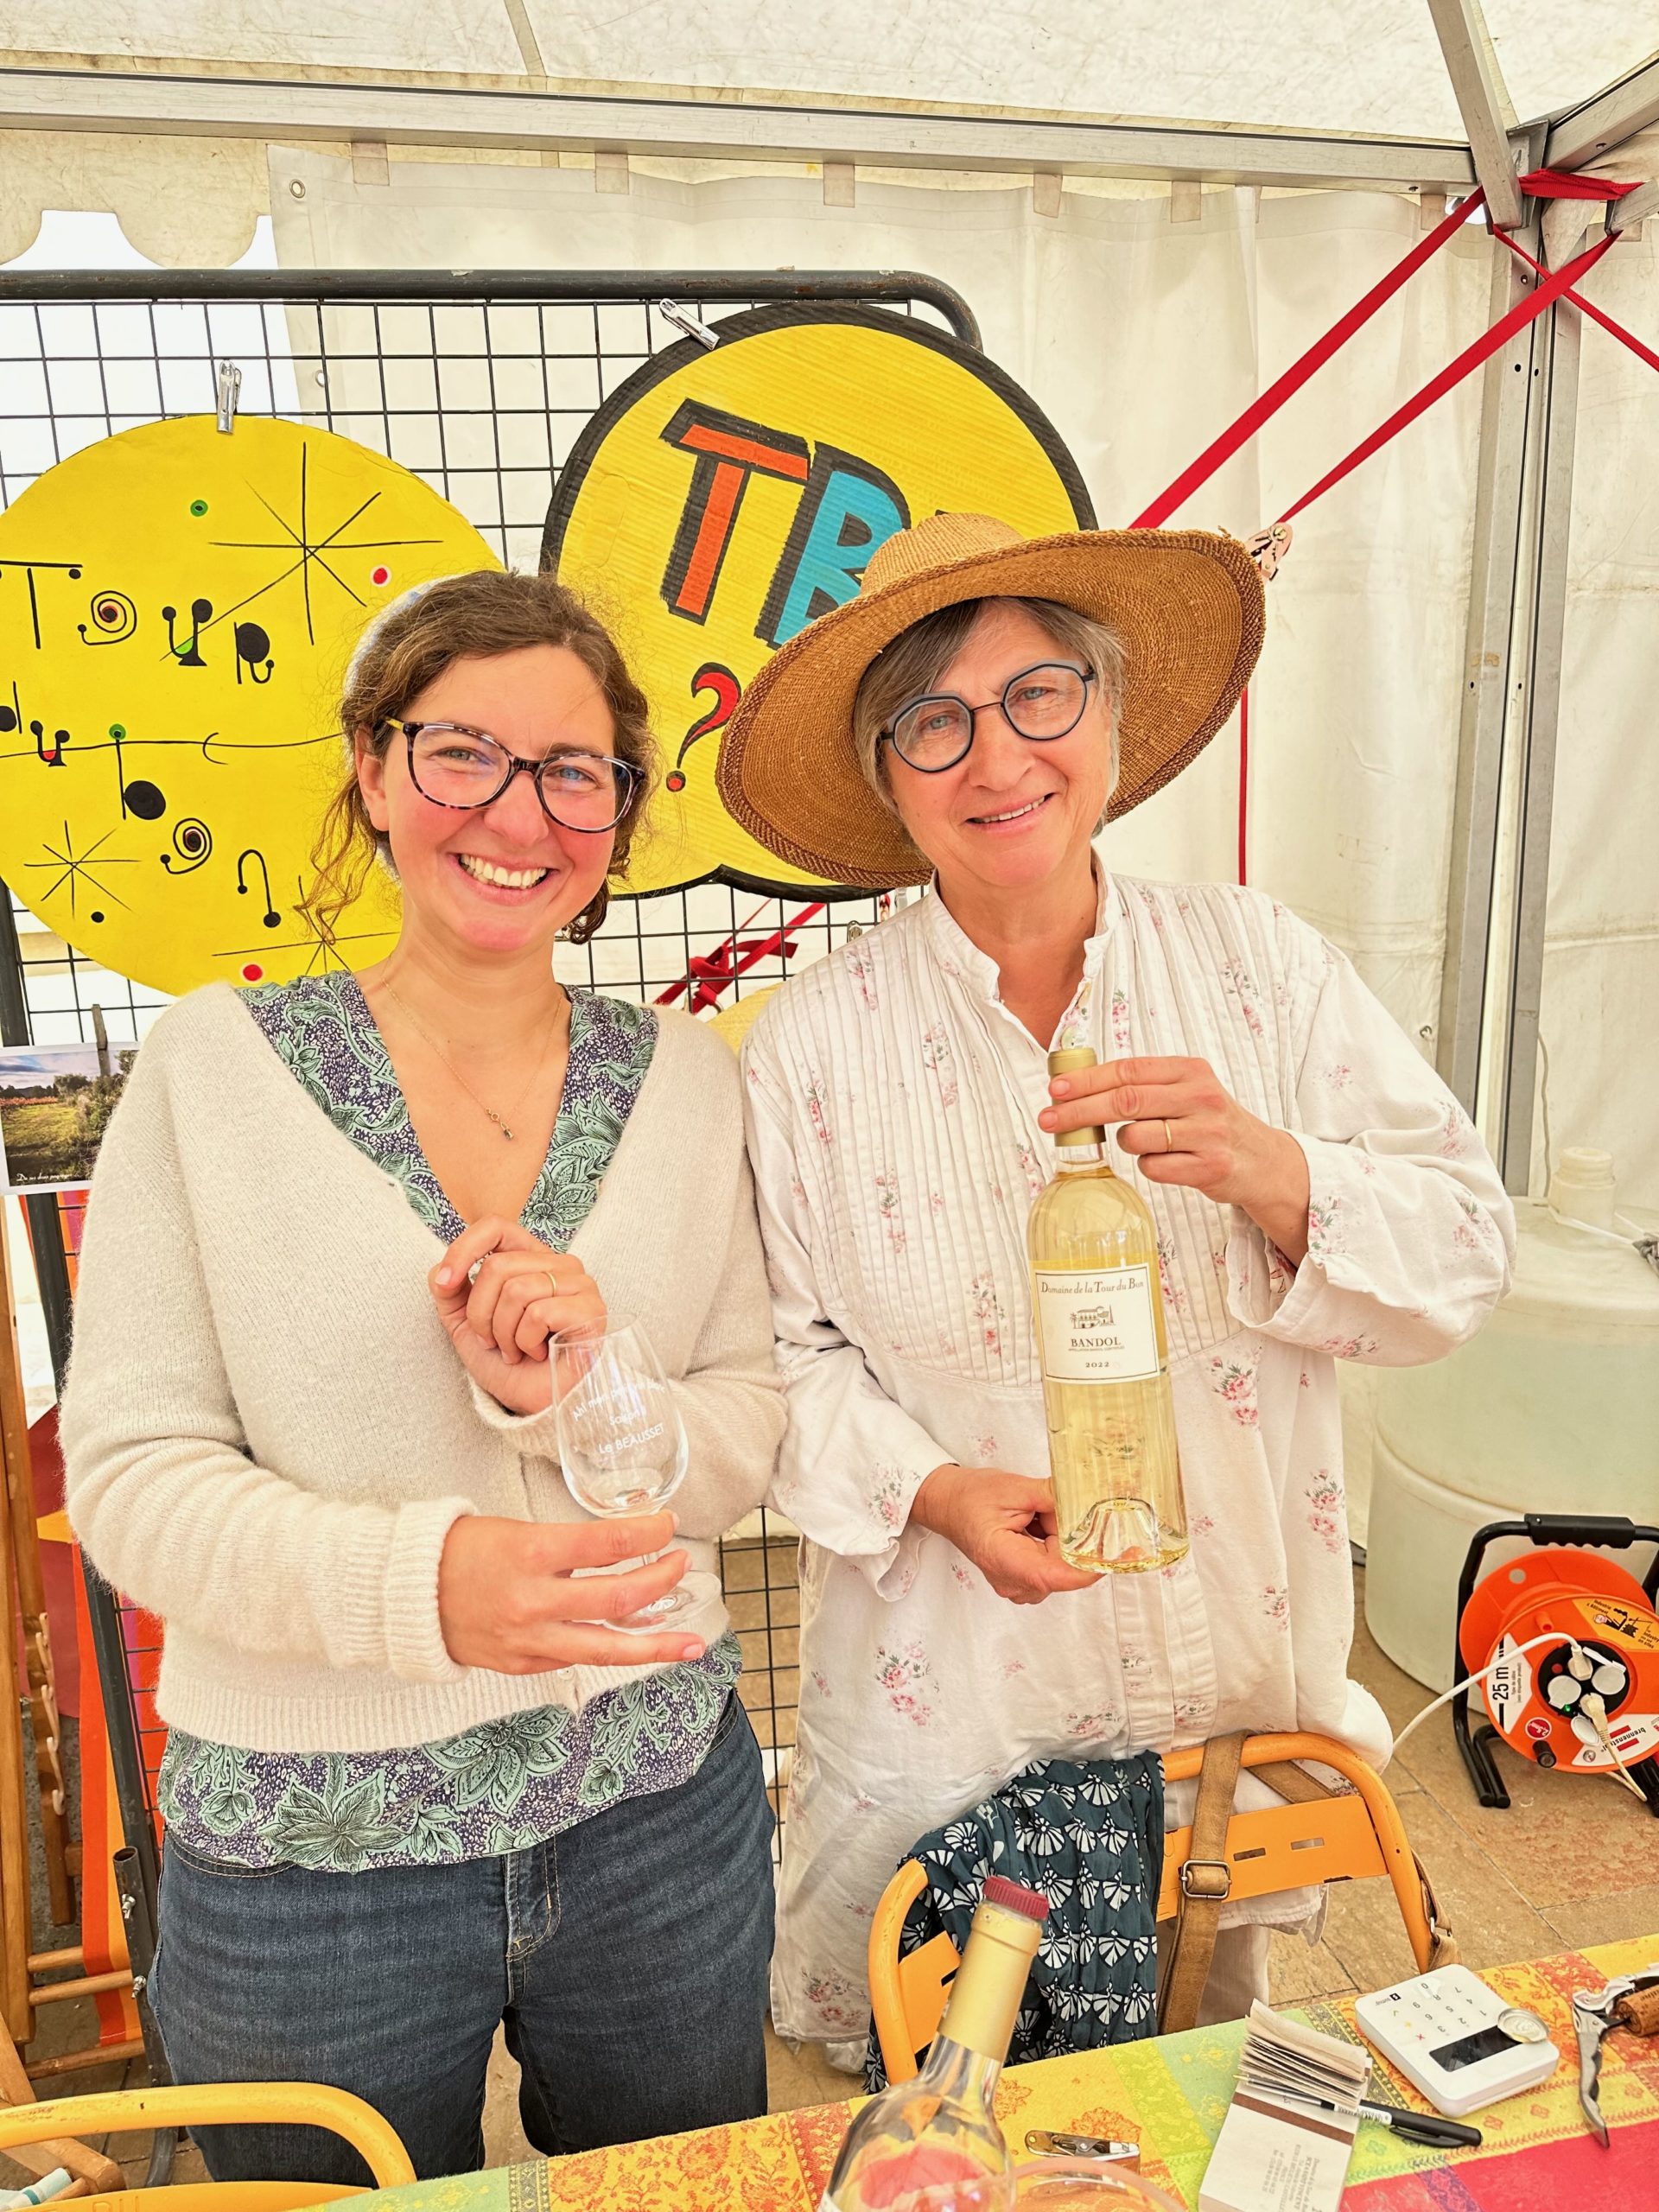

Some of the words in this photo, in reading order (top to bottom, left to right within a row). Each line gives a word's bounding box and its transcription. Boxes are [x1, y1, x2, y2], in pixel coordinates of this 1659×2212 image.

[1041, 1281, 1072, 1294] Domaine
[1074, 1281, 1083, 1294] de
[1084, 1281, 1093, 1293] la
[1094, 1281, 1116, 1293] Tour
[1116, 1279, 1127, 1290] du
[1071, 1337, 1122, 1348] BANDOL
[1496, 1667, 1509, 1680] m
[1492, 1683, 1509, 1700] 25
[1602, 1726, 1647, 1751] brennenstl
